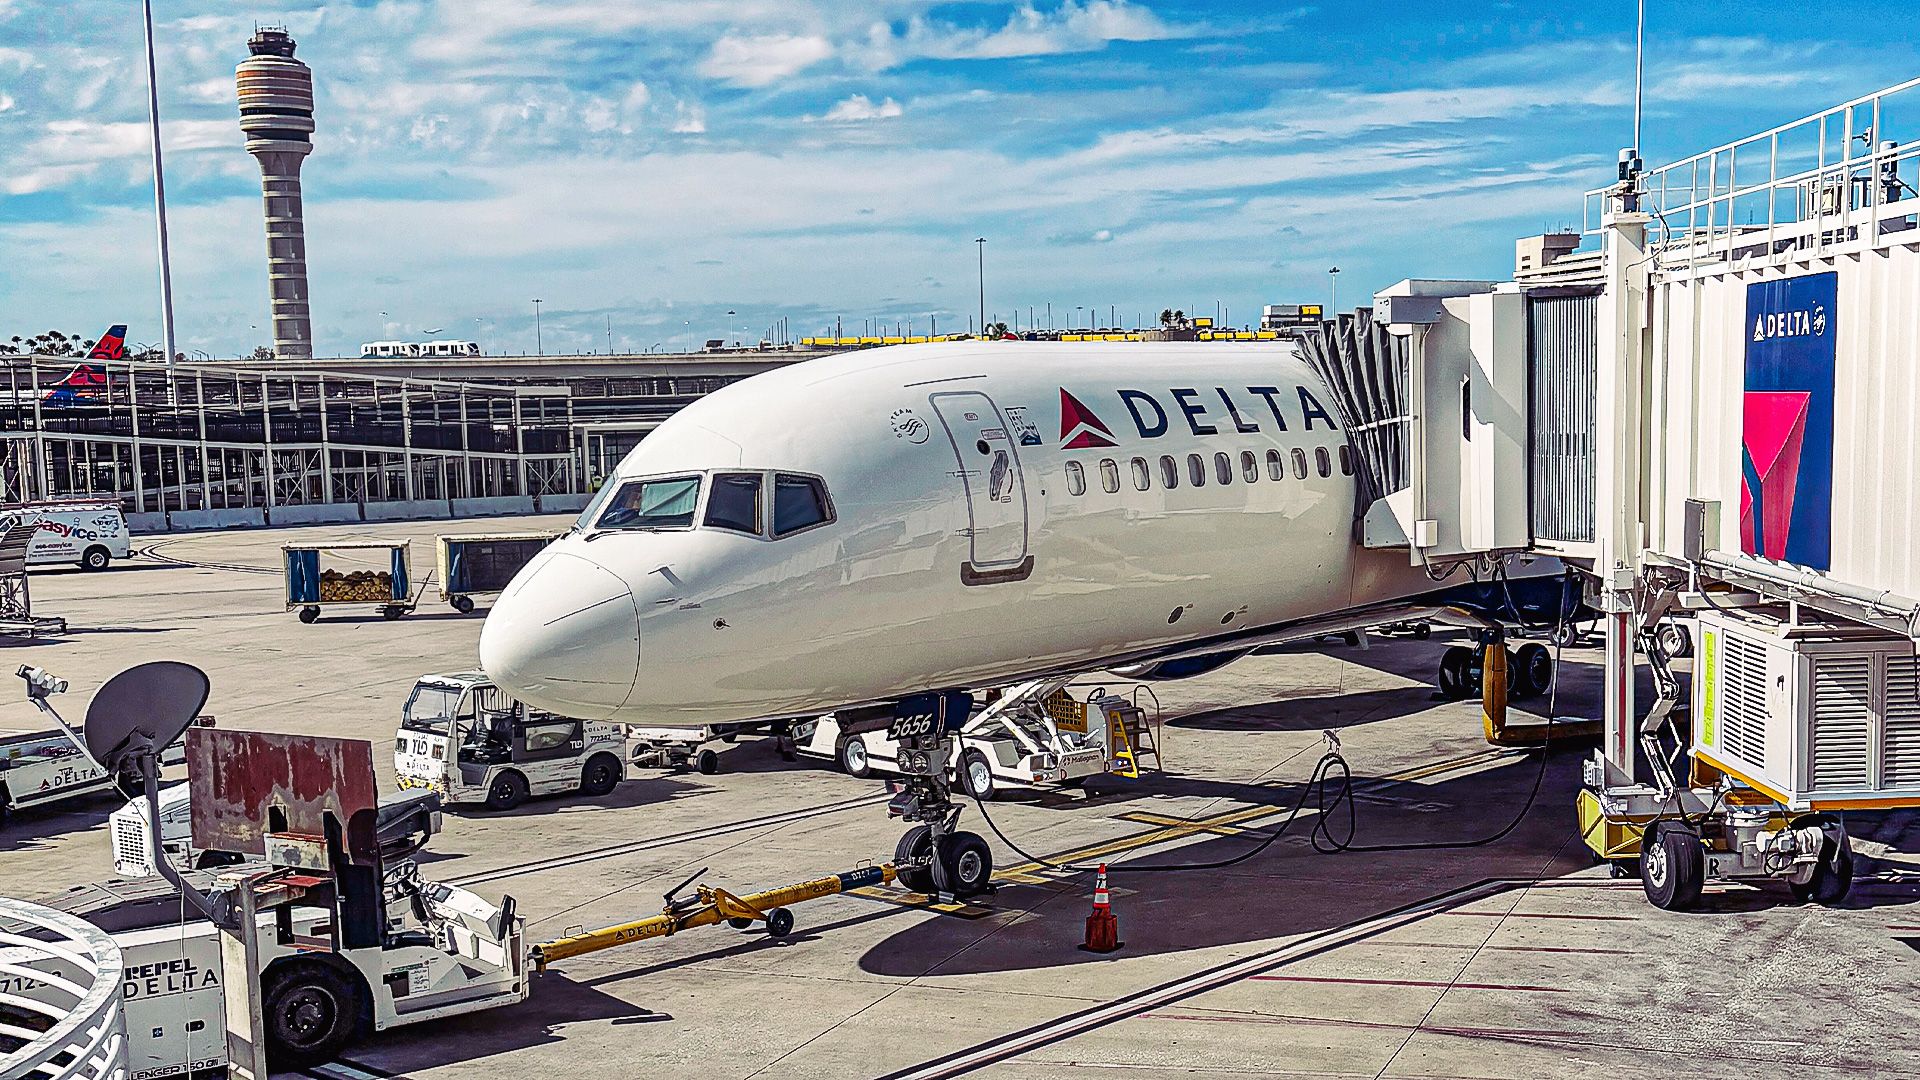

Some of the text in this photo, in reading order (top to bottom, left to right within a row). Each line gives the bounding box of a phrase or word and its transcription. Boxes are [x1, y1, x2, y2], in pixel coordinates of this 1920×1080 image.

[1767, 312, 1809, 337] DELTA
[1116, 385, 1338, 439] DELTA
[889, 713, 933, 738] 5656
[412, 738, 428, 755] TLD
[569, 740, 583, 750] TLD
[54, 768, 98, 787] DELTA
[1709, 857, 1720, 876] R
[628, 921, 667, 938] DELTA
[122, 968, 219, 1000] DELTA
